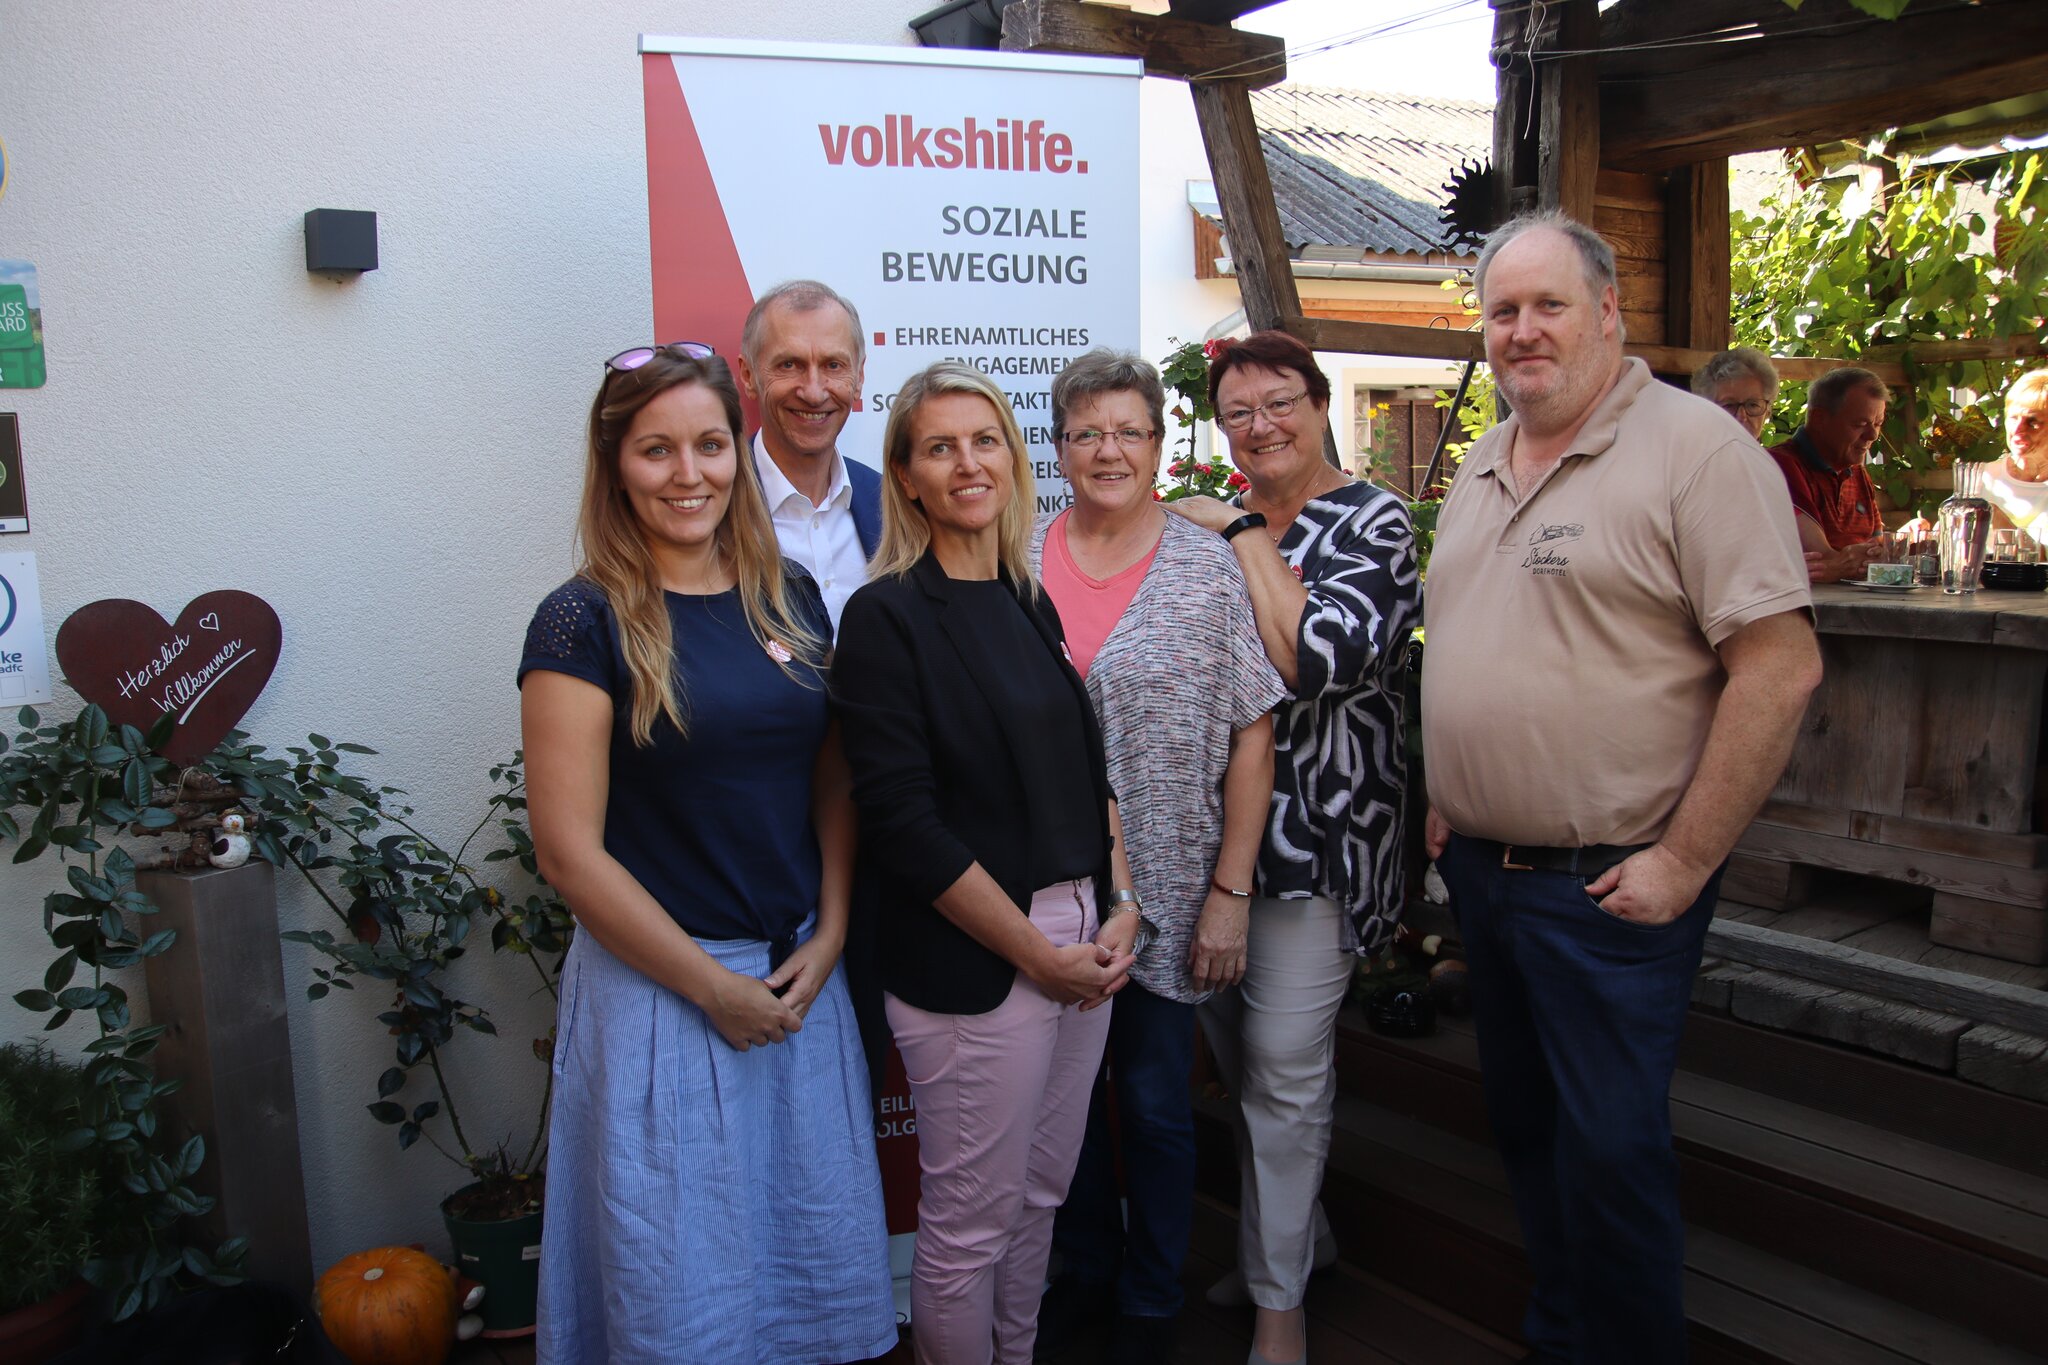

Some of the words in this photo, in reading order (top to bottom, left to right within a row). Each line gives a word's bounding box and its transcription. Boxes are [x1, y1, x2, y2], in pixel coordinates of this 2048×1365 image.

[818, 114, 1088, 174] volkshilfe.
[941, 205, 1088, 239] SOZIALE
[882, 252, 1088, 285] BEWEGUNG
[895, 327, 1090, 347] EHRENAMTLICHES
[1521, 546, 1569, 568] Stockers
[1532, 567, 1567, 577] DORFHOTEL
[0, 664, 24, 674] adfc
[116, 633, 190, 699] Herzlich
[151, 638, 242, 714] Willkommen
